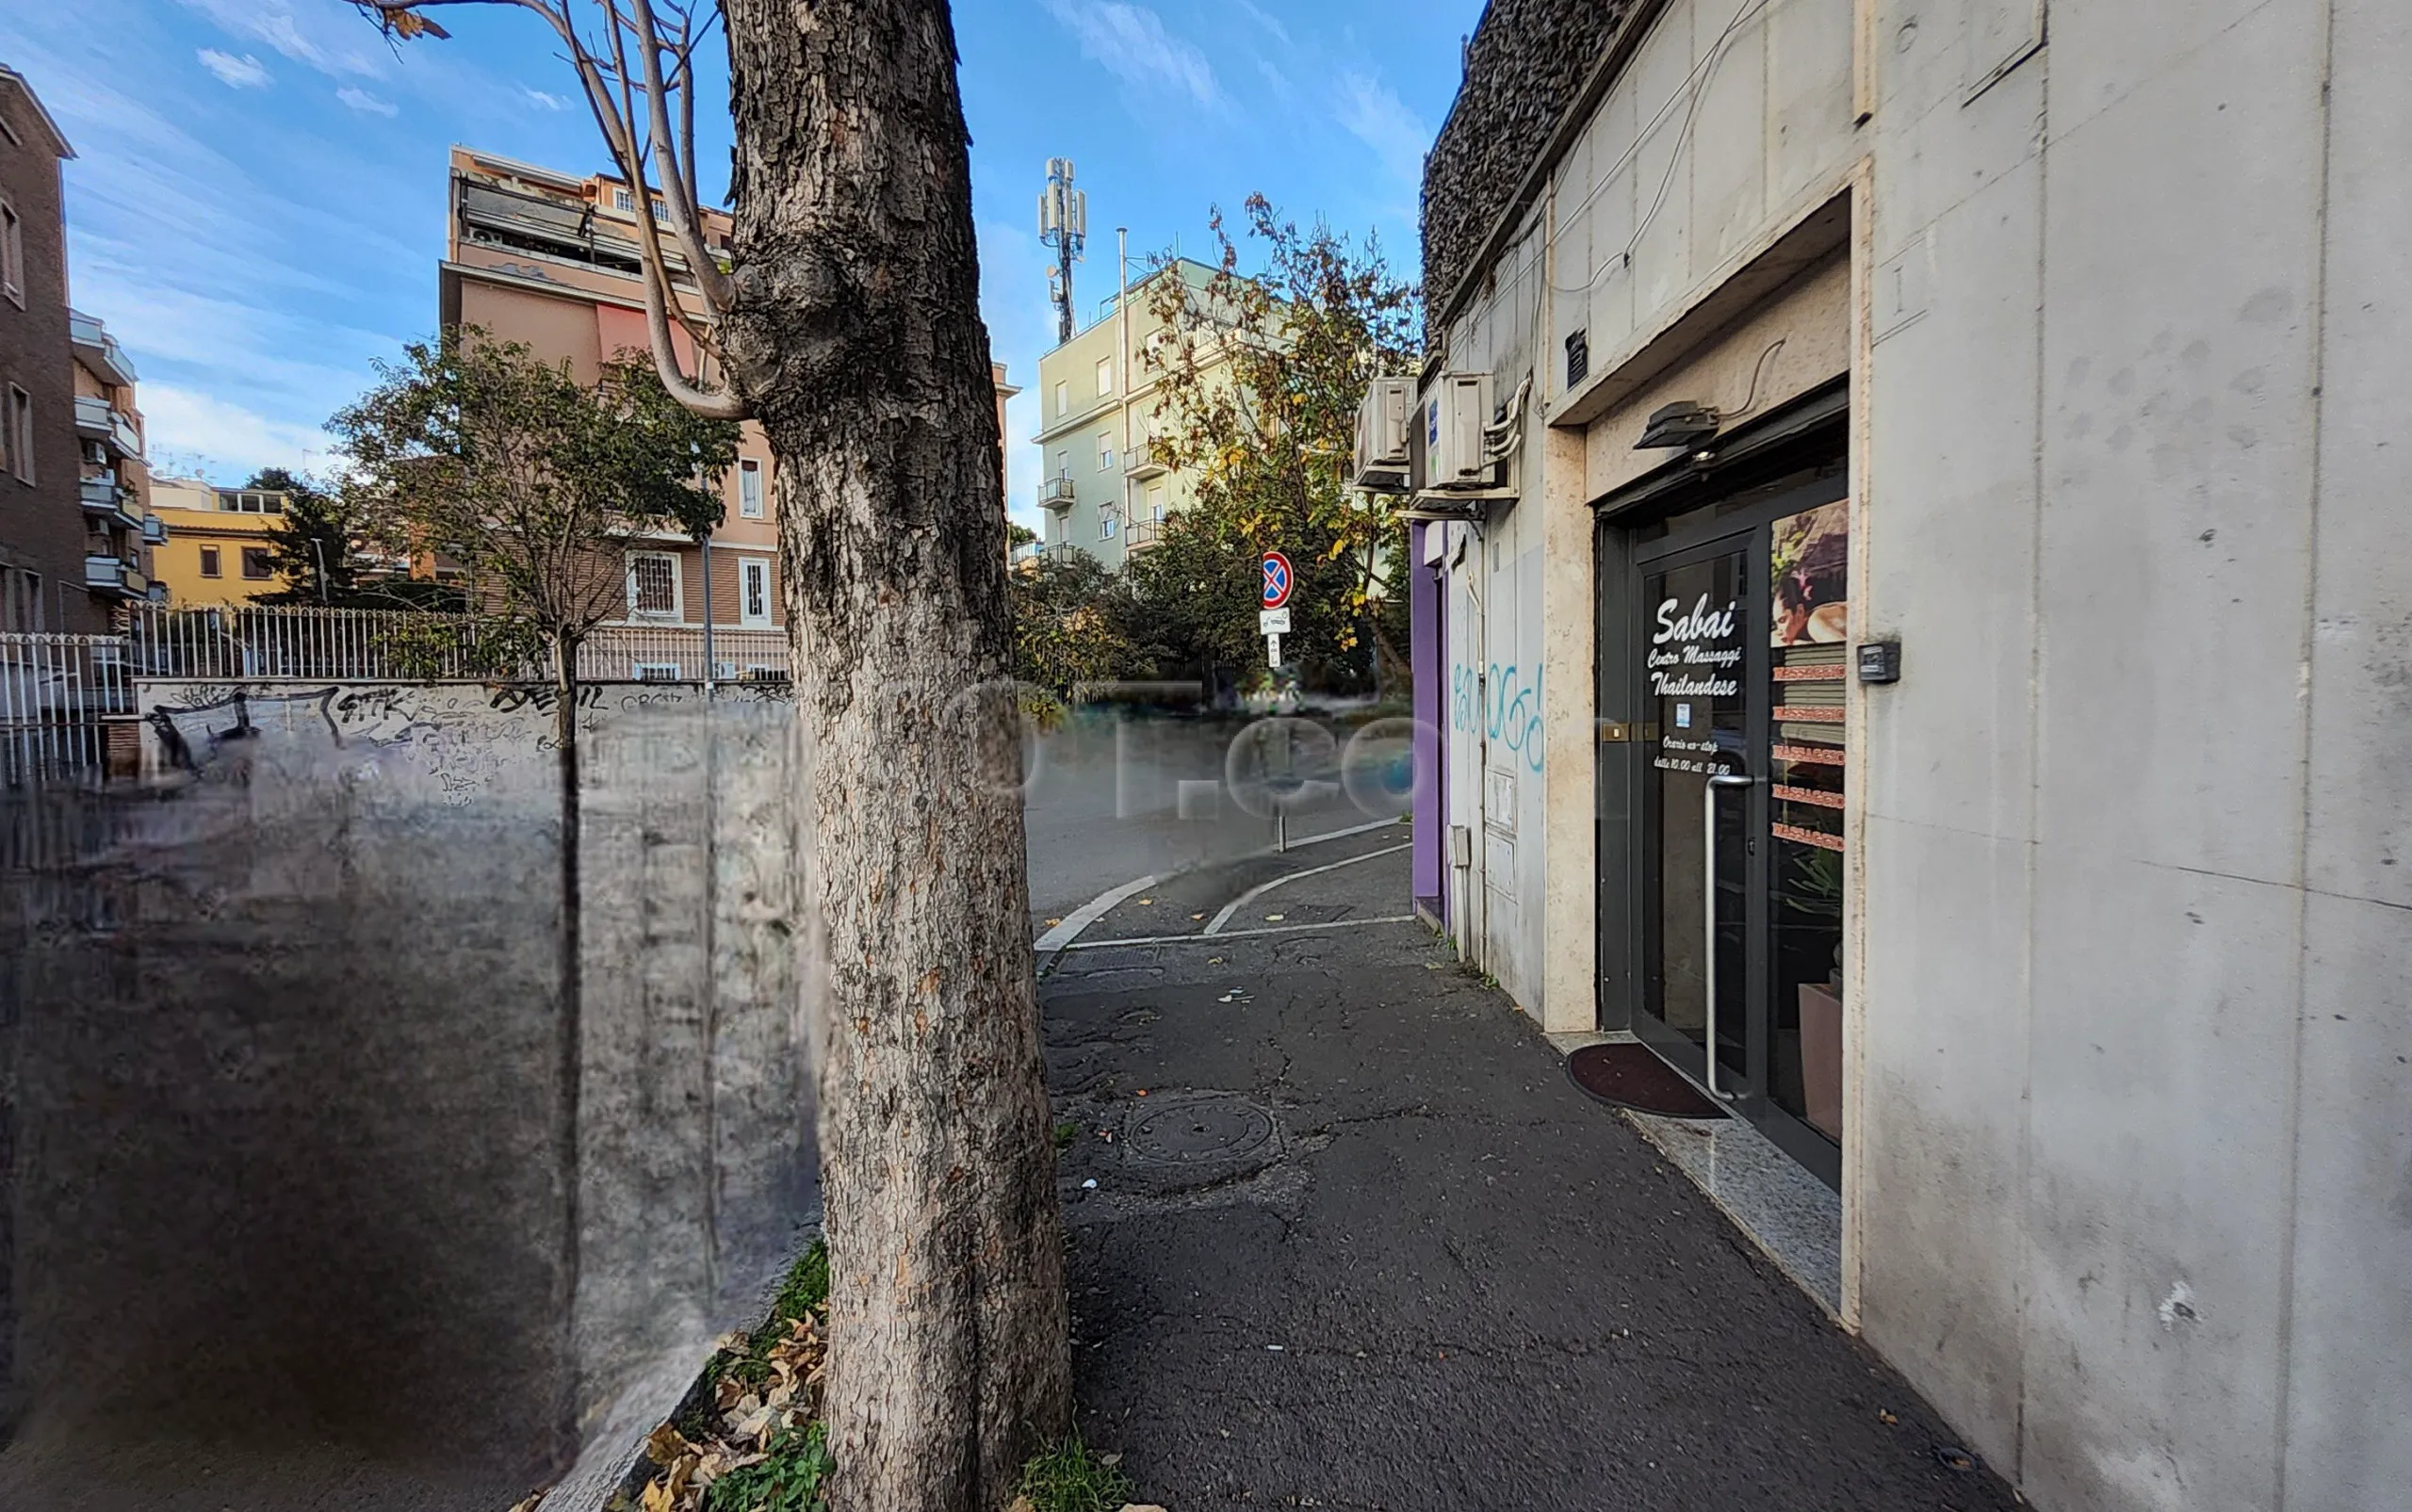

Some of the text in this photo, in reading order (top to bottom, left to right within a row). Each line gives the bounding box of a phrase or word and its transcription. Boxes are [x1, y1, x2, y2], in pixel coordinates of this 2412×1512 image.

[1653, 593, 1736, 644] Sabai
[1647, 644, 1742, 669] Centro Massaggi
[1651, 671, 1737, 696] Thailandese
[1772, 744, 1846, 765] MASSAGGIO
